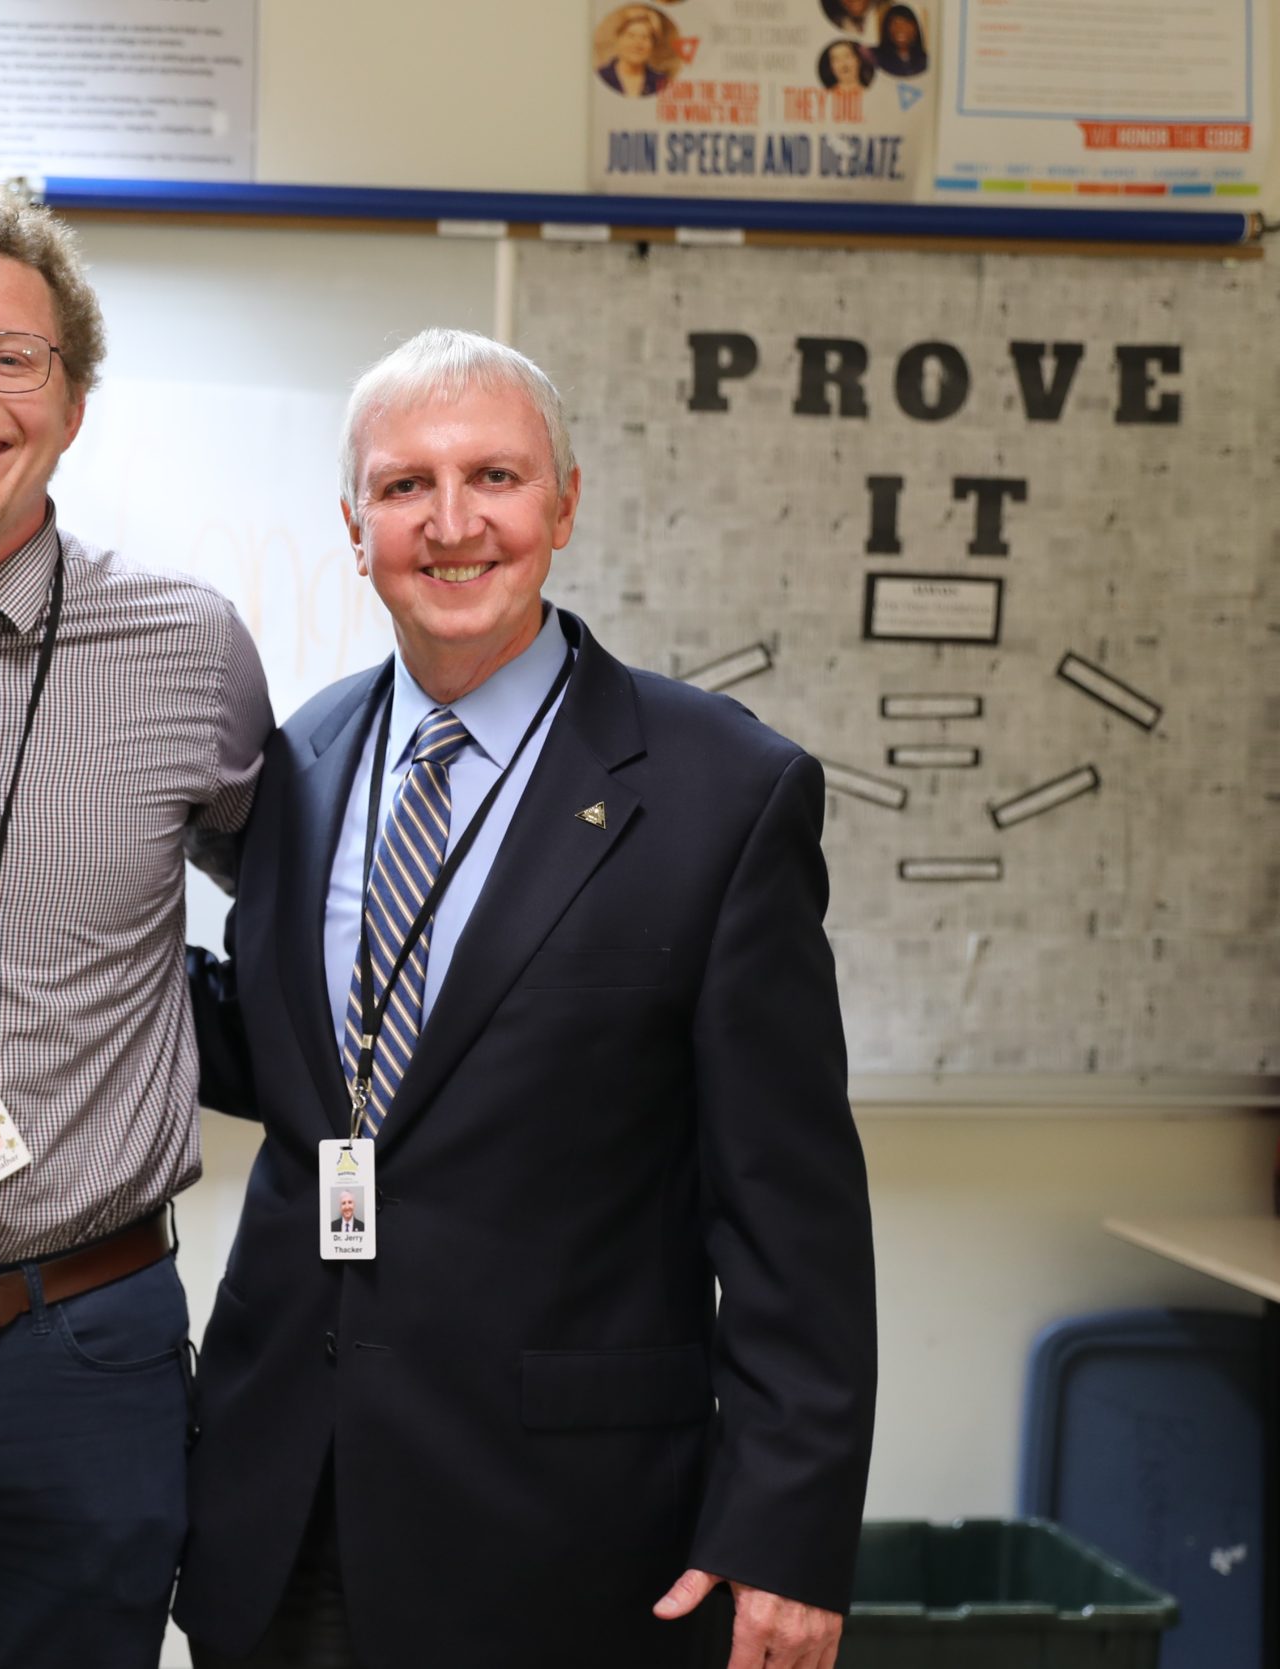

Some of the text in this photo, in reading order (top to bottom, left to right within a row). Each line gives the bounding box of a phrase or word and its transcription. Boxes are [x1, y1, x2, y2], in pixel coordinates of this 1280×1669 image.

[783, 87, 828, 123] THEY
[607, 130, 658, 174] JOIN
[665, 130, 756, 176] SPEECH
[762, 133, 812, 177] AND
[687, 331, 1182, 425] PROVE
[864, 475, 1028, 557] IT
[334, 1246, 363, 1254] Thacker
[344, 1234, 363, 1243] Jerry
